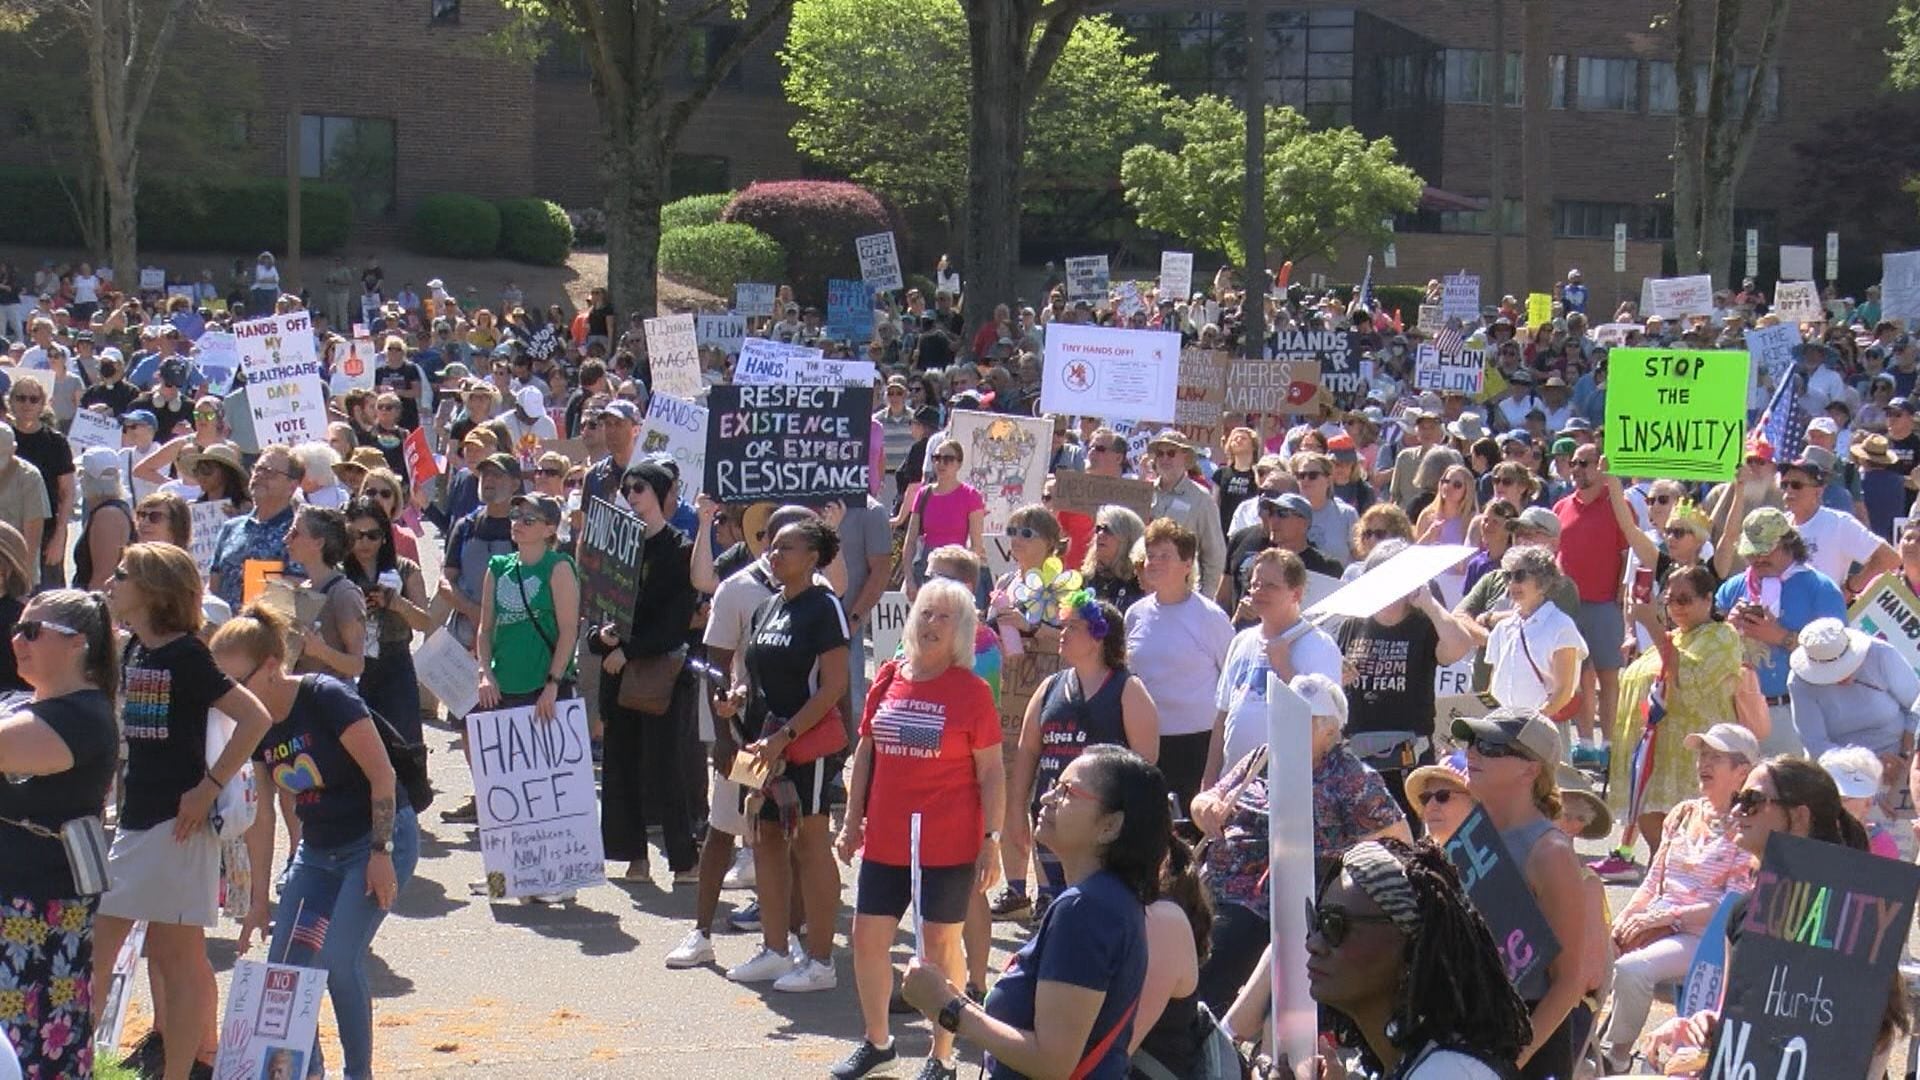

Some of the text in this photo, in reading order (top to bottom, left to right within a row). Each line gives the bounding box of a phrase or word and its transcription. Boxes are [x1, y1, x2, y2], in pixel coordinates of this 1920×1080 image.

[1446, 287, 1476, 297] MUSK
[236, 318, 308, 338] HANDS OFF
[265, 337, 282, 349] MY
[1062, 343, 1134, 357] TINY HANDS OFF!
[1277, 331, 1347, 350] HANDS
[651, 351, 697, 368] MAGA
[745, 357, 784, 378] HANDS
[1645, 357, 1704, 380] STOP
[739, 387, 845, 408] RESPECT
[1177, 385, 1207, 401] LAW
[1657, 388, 1690, 404] THE
[649, 394, 704, 432] HANDS
[275, 418, 307, 433] VOTE
[720, 412, 850, 438] EXISTENCE
[745, 439, 862, 461] OR EXPECT
[716, 459, 869, 495] RESISTANCE
[584, 499, 642, 568] HANDS OFF
[1358, 660, 1407, 674] EEDOM
[1352, 676, 1407, 692] OT FEAR
[909, 700, 945, 713] PEOPLE
[477, 705, 583, 776] HANDS
[885, 744, 908, 756] NOT
[910, 746, 942, 758] OKAY
[487, 771, 574, 822] OFF
[1744, 871, 1903, 964] EQUALITY
[271, 972, 291, 989] NO
[1764, 965, 1834, 1026] Hurts
